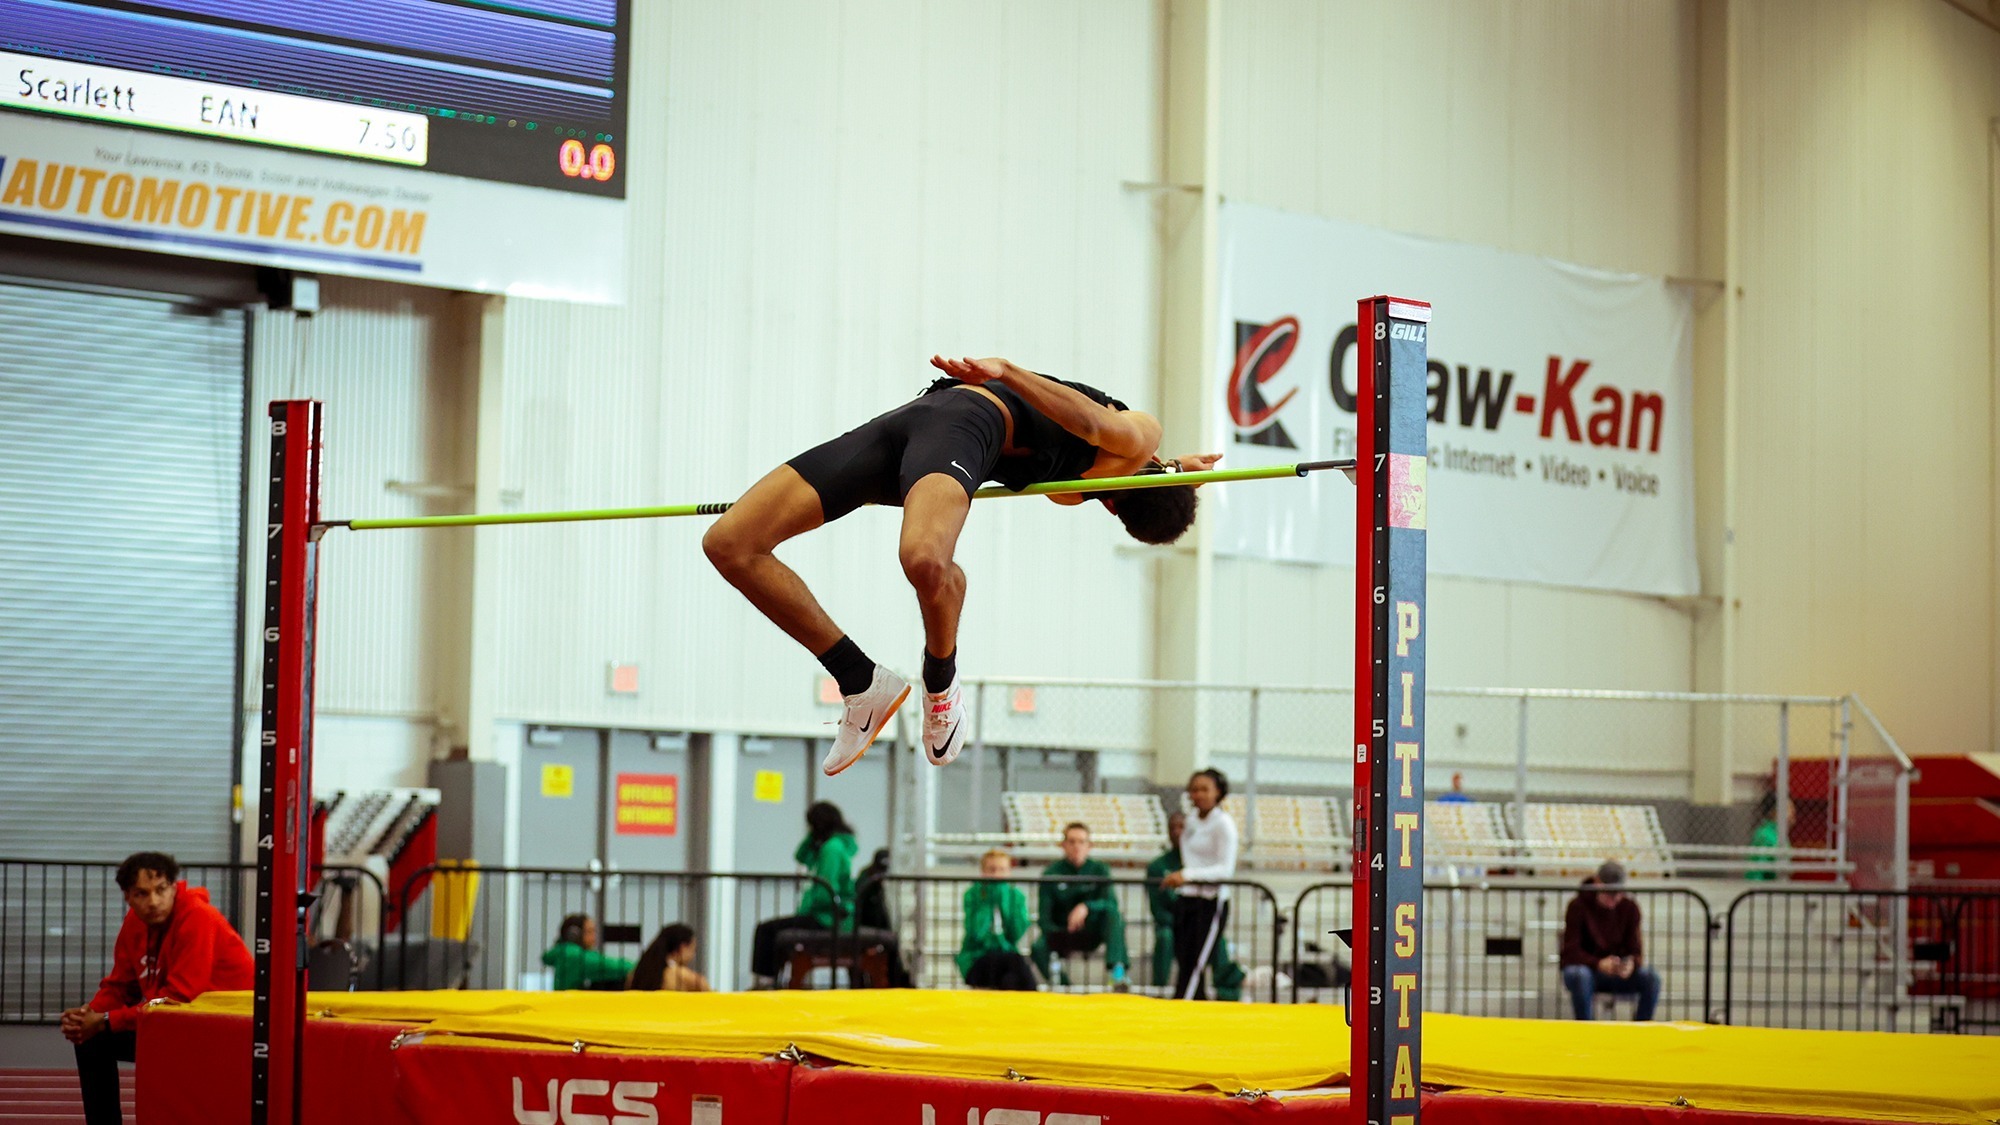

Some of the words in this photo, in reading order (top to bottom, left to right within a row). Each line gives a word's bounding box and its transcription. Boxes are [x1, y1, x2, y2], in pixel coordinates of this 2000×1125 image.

[18, 69, 135, 112] Scarlett
[201, 95, 258, 129] EAN
[359, 118, 416, 151] 7.50
[559, 139, 615, 181] 0.0
[0, 157, 427, 255] AUTOMOTIVE.COM
[1375, 322, 1386, 340] 8
[1391, 323, 1426, 343] GILL
[1330, 323, 1665, 453] Caw-Kan
[271, 421, 287, 436] 8
[1374, 453, 1387, 473] 7
[267, 523, 284, 540] 7
[1373, 586, 1385, 604] 6
[264, 627, 281, 643] 6
[931, 701, 952, 713] NIKE
[1372, 719, 1385, 738] 5
[1394, 600, 1420, 868] PITT
[262, 731, 277, 746] 5
[258, 834, 274, 850] 4
[1371, 852, 1384, 871] 4
[256, 938, 271, 954] 3
[1370, 986, 1382, 1005] 3
[1390, 903, 1416, 1125] STA
[254, 1042, 269, 1058] 2
[512, 1076, 659, 1125] UCS
